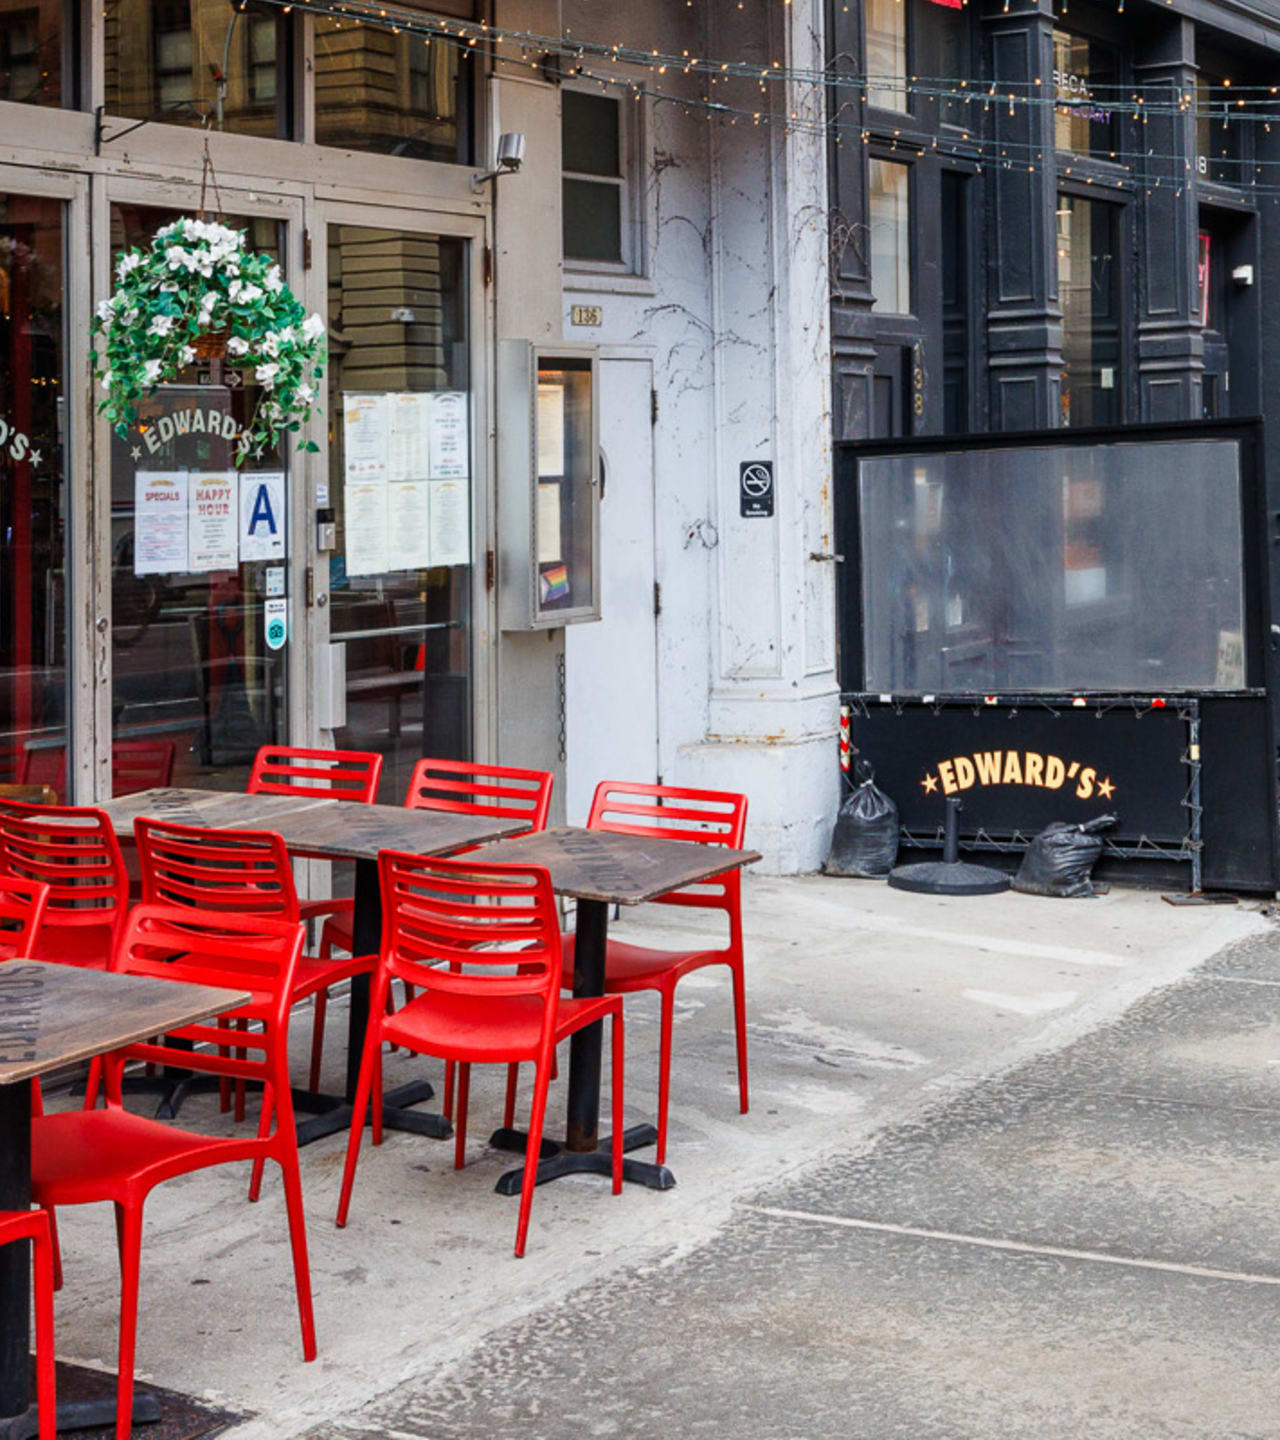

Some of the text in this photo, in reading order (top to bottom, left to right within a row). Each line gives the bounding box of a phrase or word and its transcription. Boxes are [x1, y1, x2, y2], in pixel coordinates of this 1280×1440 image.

[143, 408, 253, 455] EDWARD'S
[144, 491, 180, 502] SPECIALS
[195, 488, 232, 501] HAPPY
[197, 503, 230, 516] HOUR
[247, 483, 277, 536] A
[937, 750, 1097, 800] EDWARD'S
